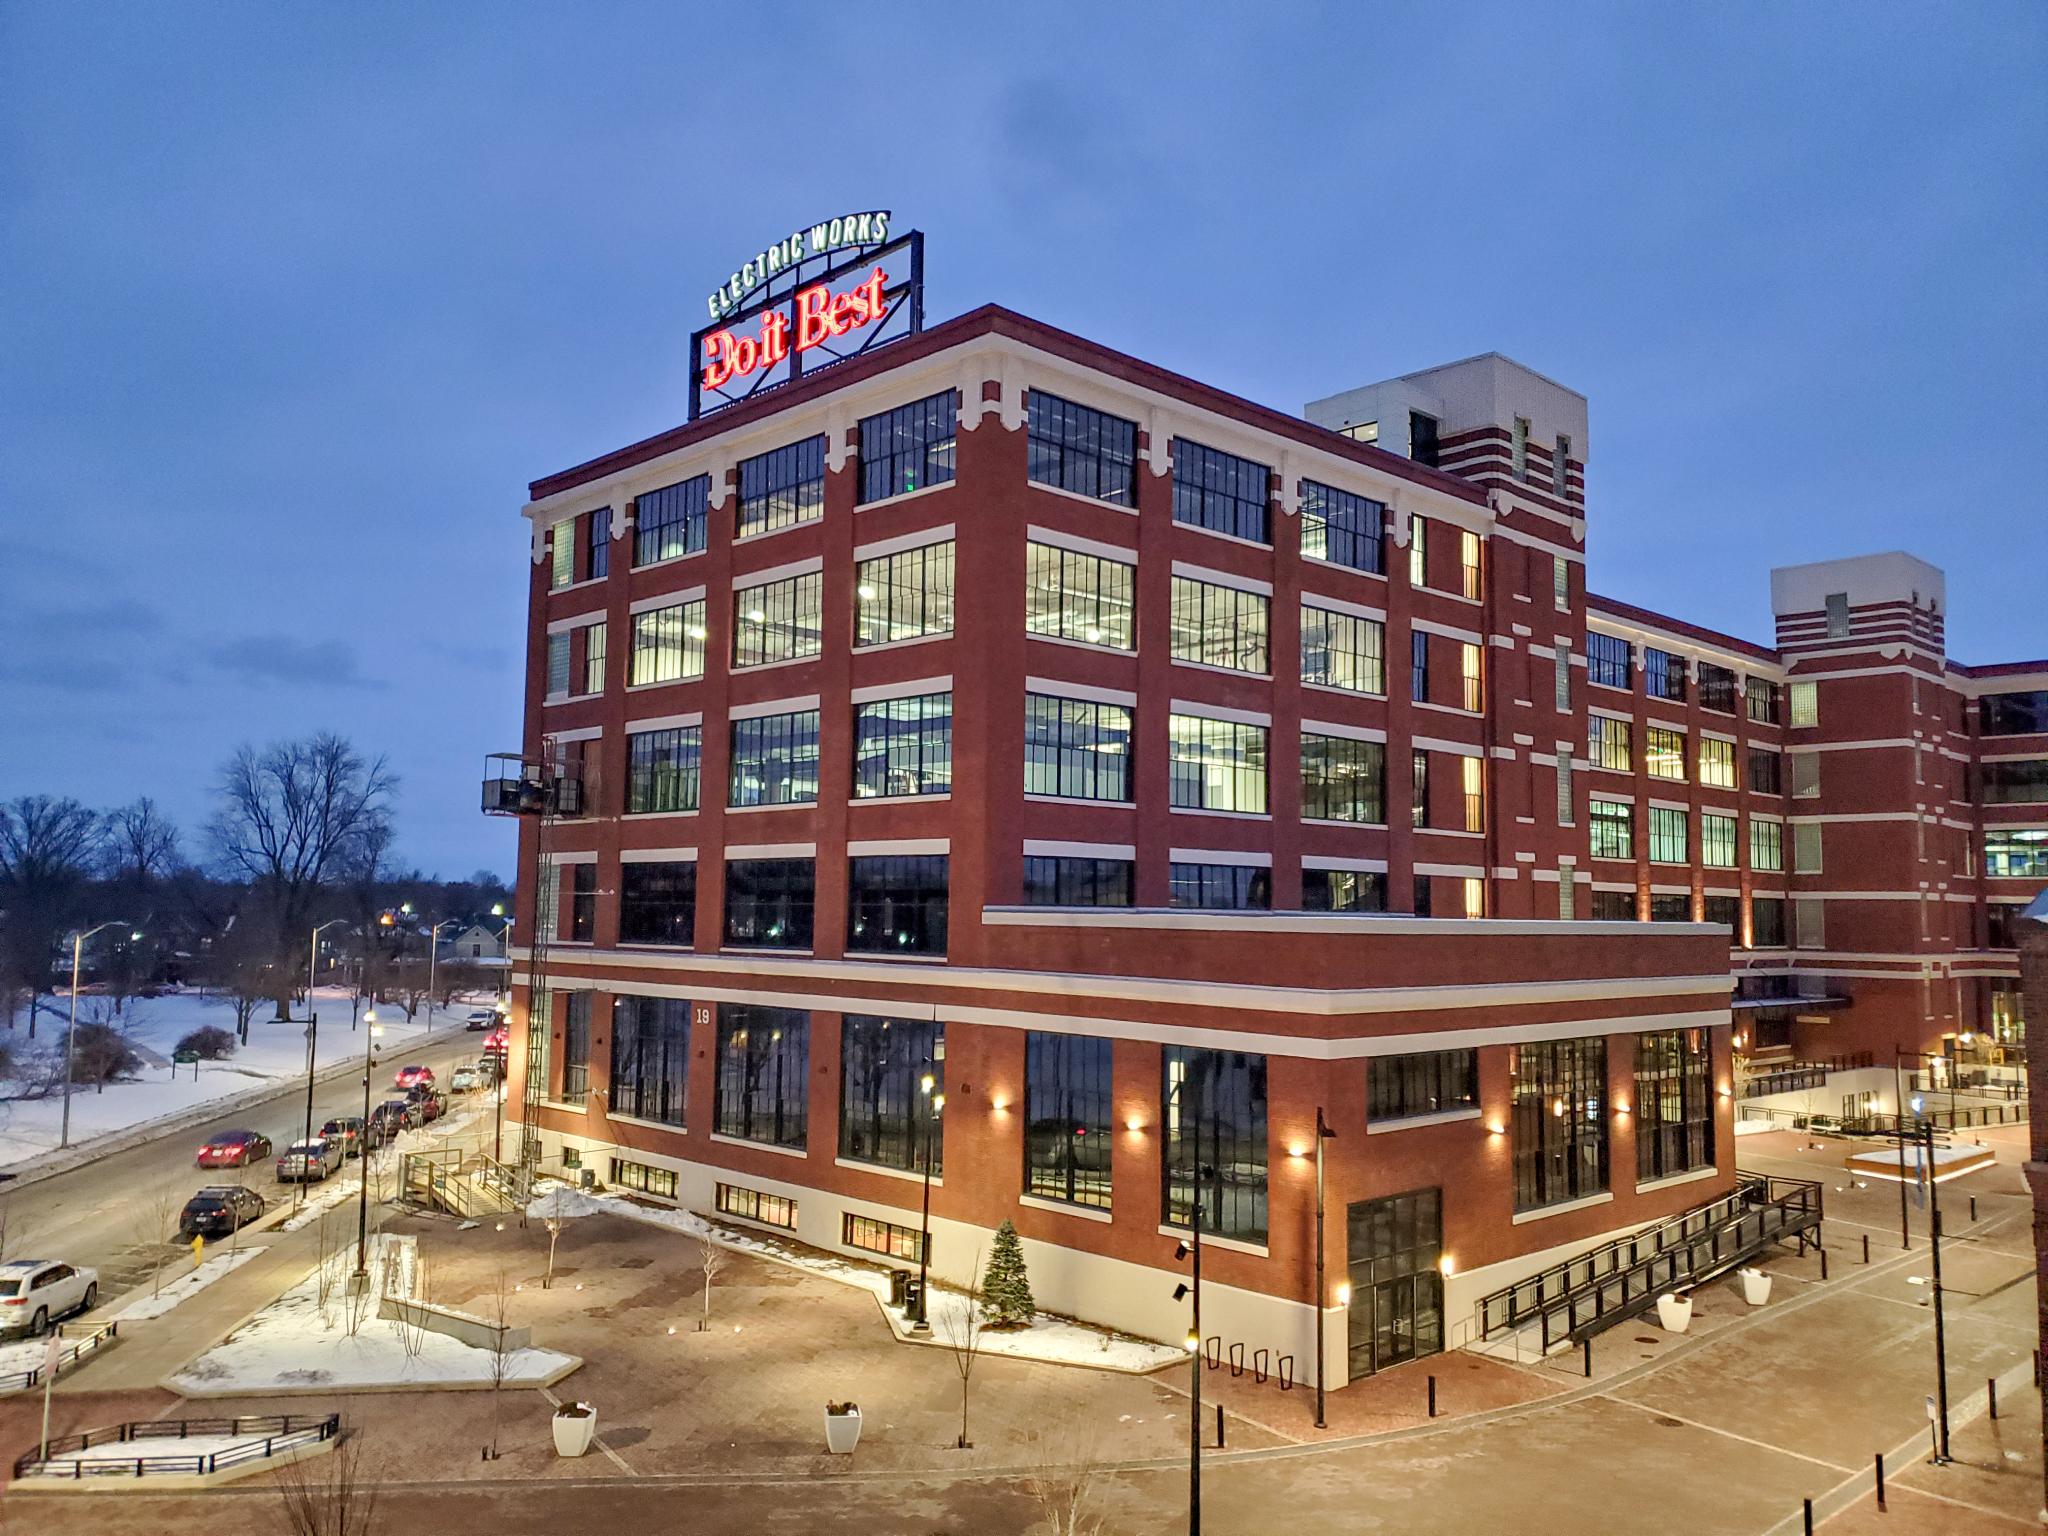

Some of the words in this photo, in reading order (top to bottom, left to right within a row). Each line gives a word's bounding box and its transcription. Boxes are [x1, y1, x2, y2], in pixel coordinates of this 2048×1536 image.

[708, 232, 804, 319] ELECTRIC
[811, 212, 888, 252] WORKS
[703, 330, 756, 390] Do
[760, 311, 789, 367] it
[796, 266, 888, 352] Best
[696, 1008, 710, 1024] 19
